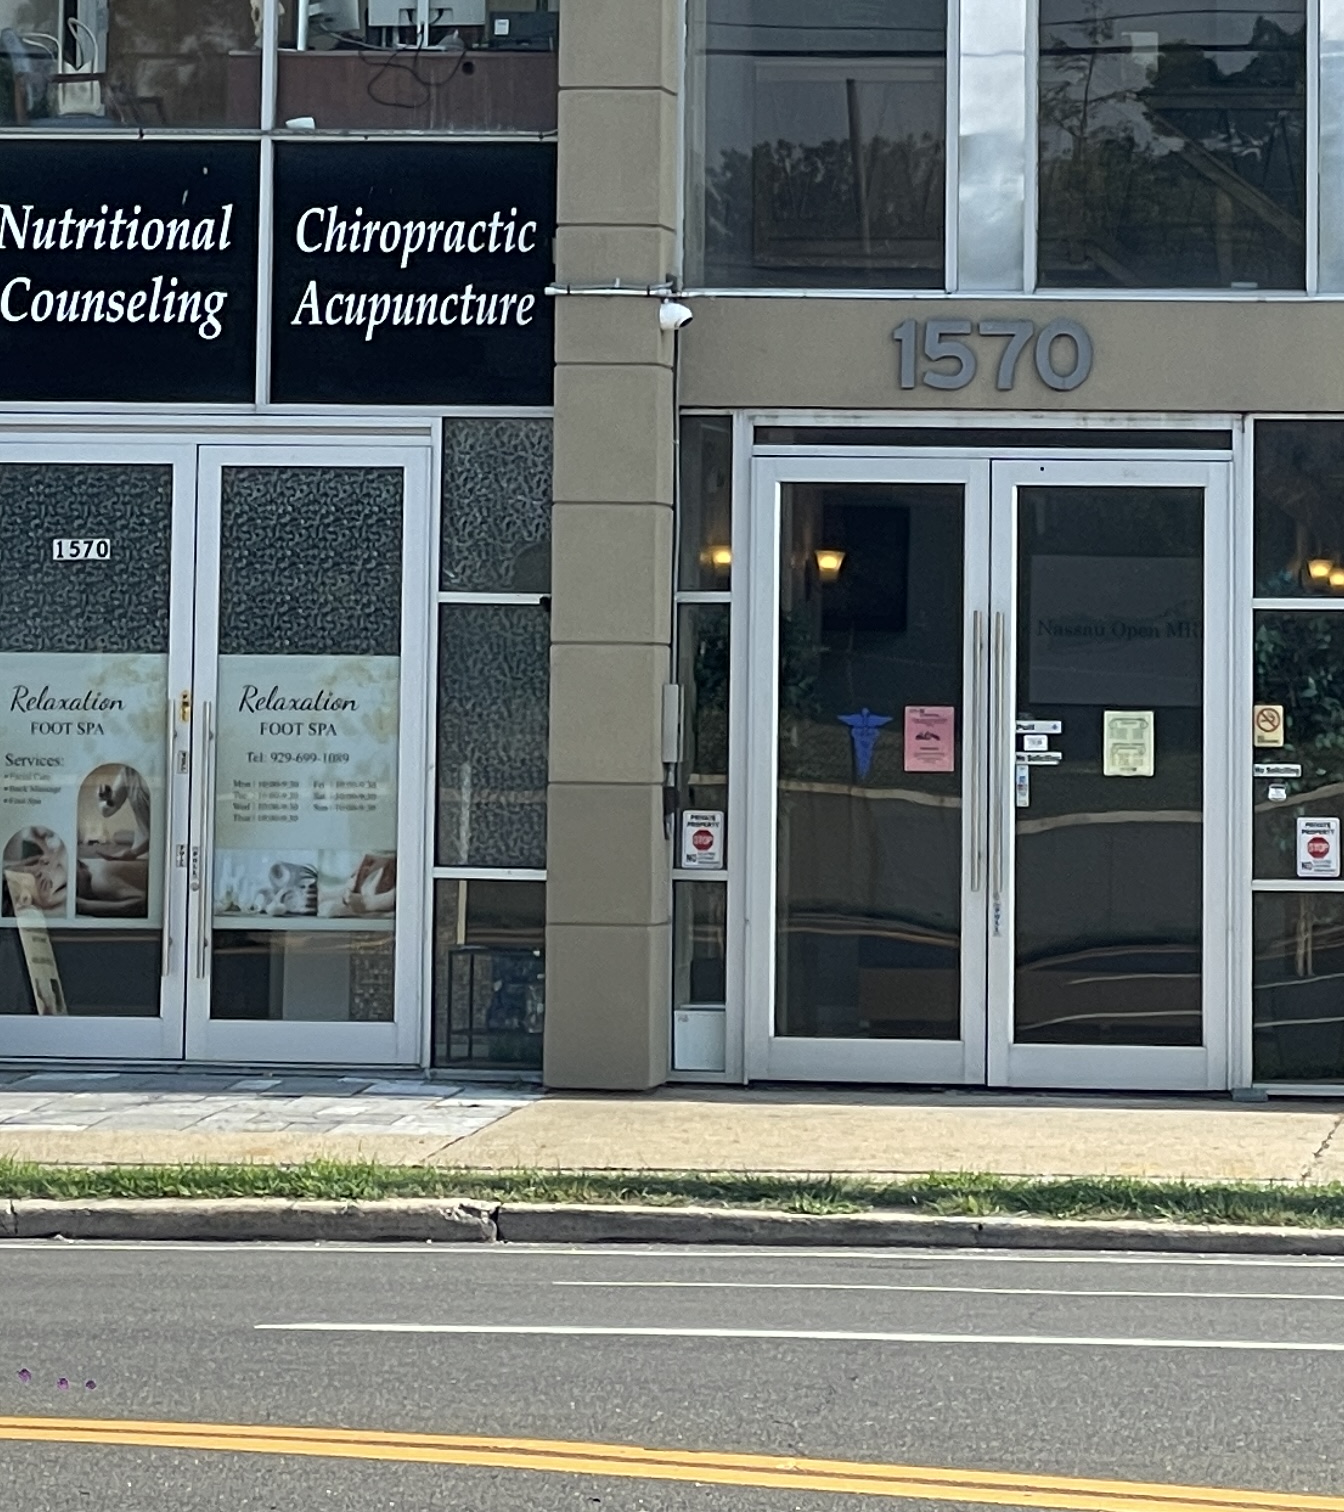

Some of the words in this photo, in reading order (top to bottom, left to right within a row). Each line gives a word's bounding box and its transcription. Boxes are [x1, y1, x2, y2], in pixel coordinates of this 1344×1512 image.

[295, 206, 538, 269] Chiropractic
[0, 275, 228, 340] Counseling
[290, 280, 536, 342] Acupuncture
[892, 318, 1094, 391] 1570
[56, 540, 109, 559] 1570
[10, 684, 126, 713] Relaxation
[238, 684, 358, 714] Relaxation
[30, 721, 74, 735] FOOT
[76, 721, 105, 736] SPA
[260, 721, 304, 736] FOOT
[307, 722, 338, 737] SPA
[270, 751, 350, 765] 929-699-1089
